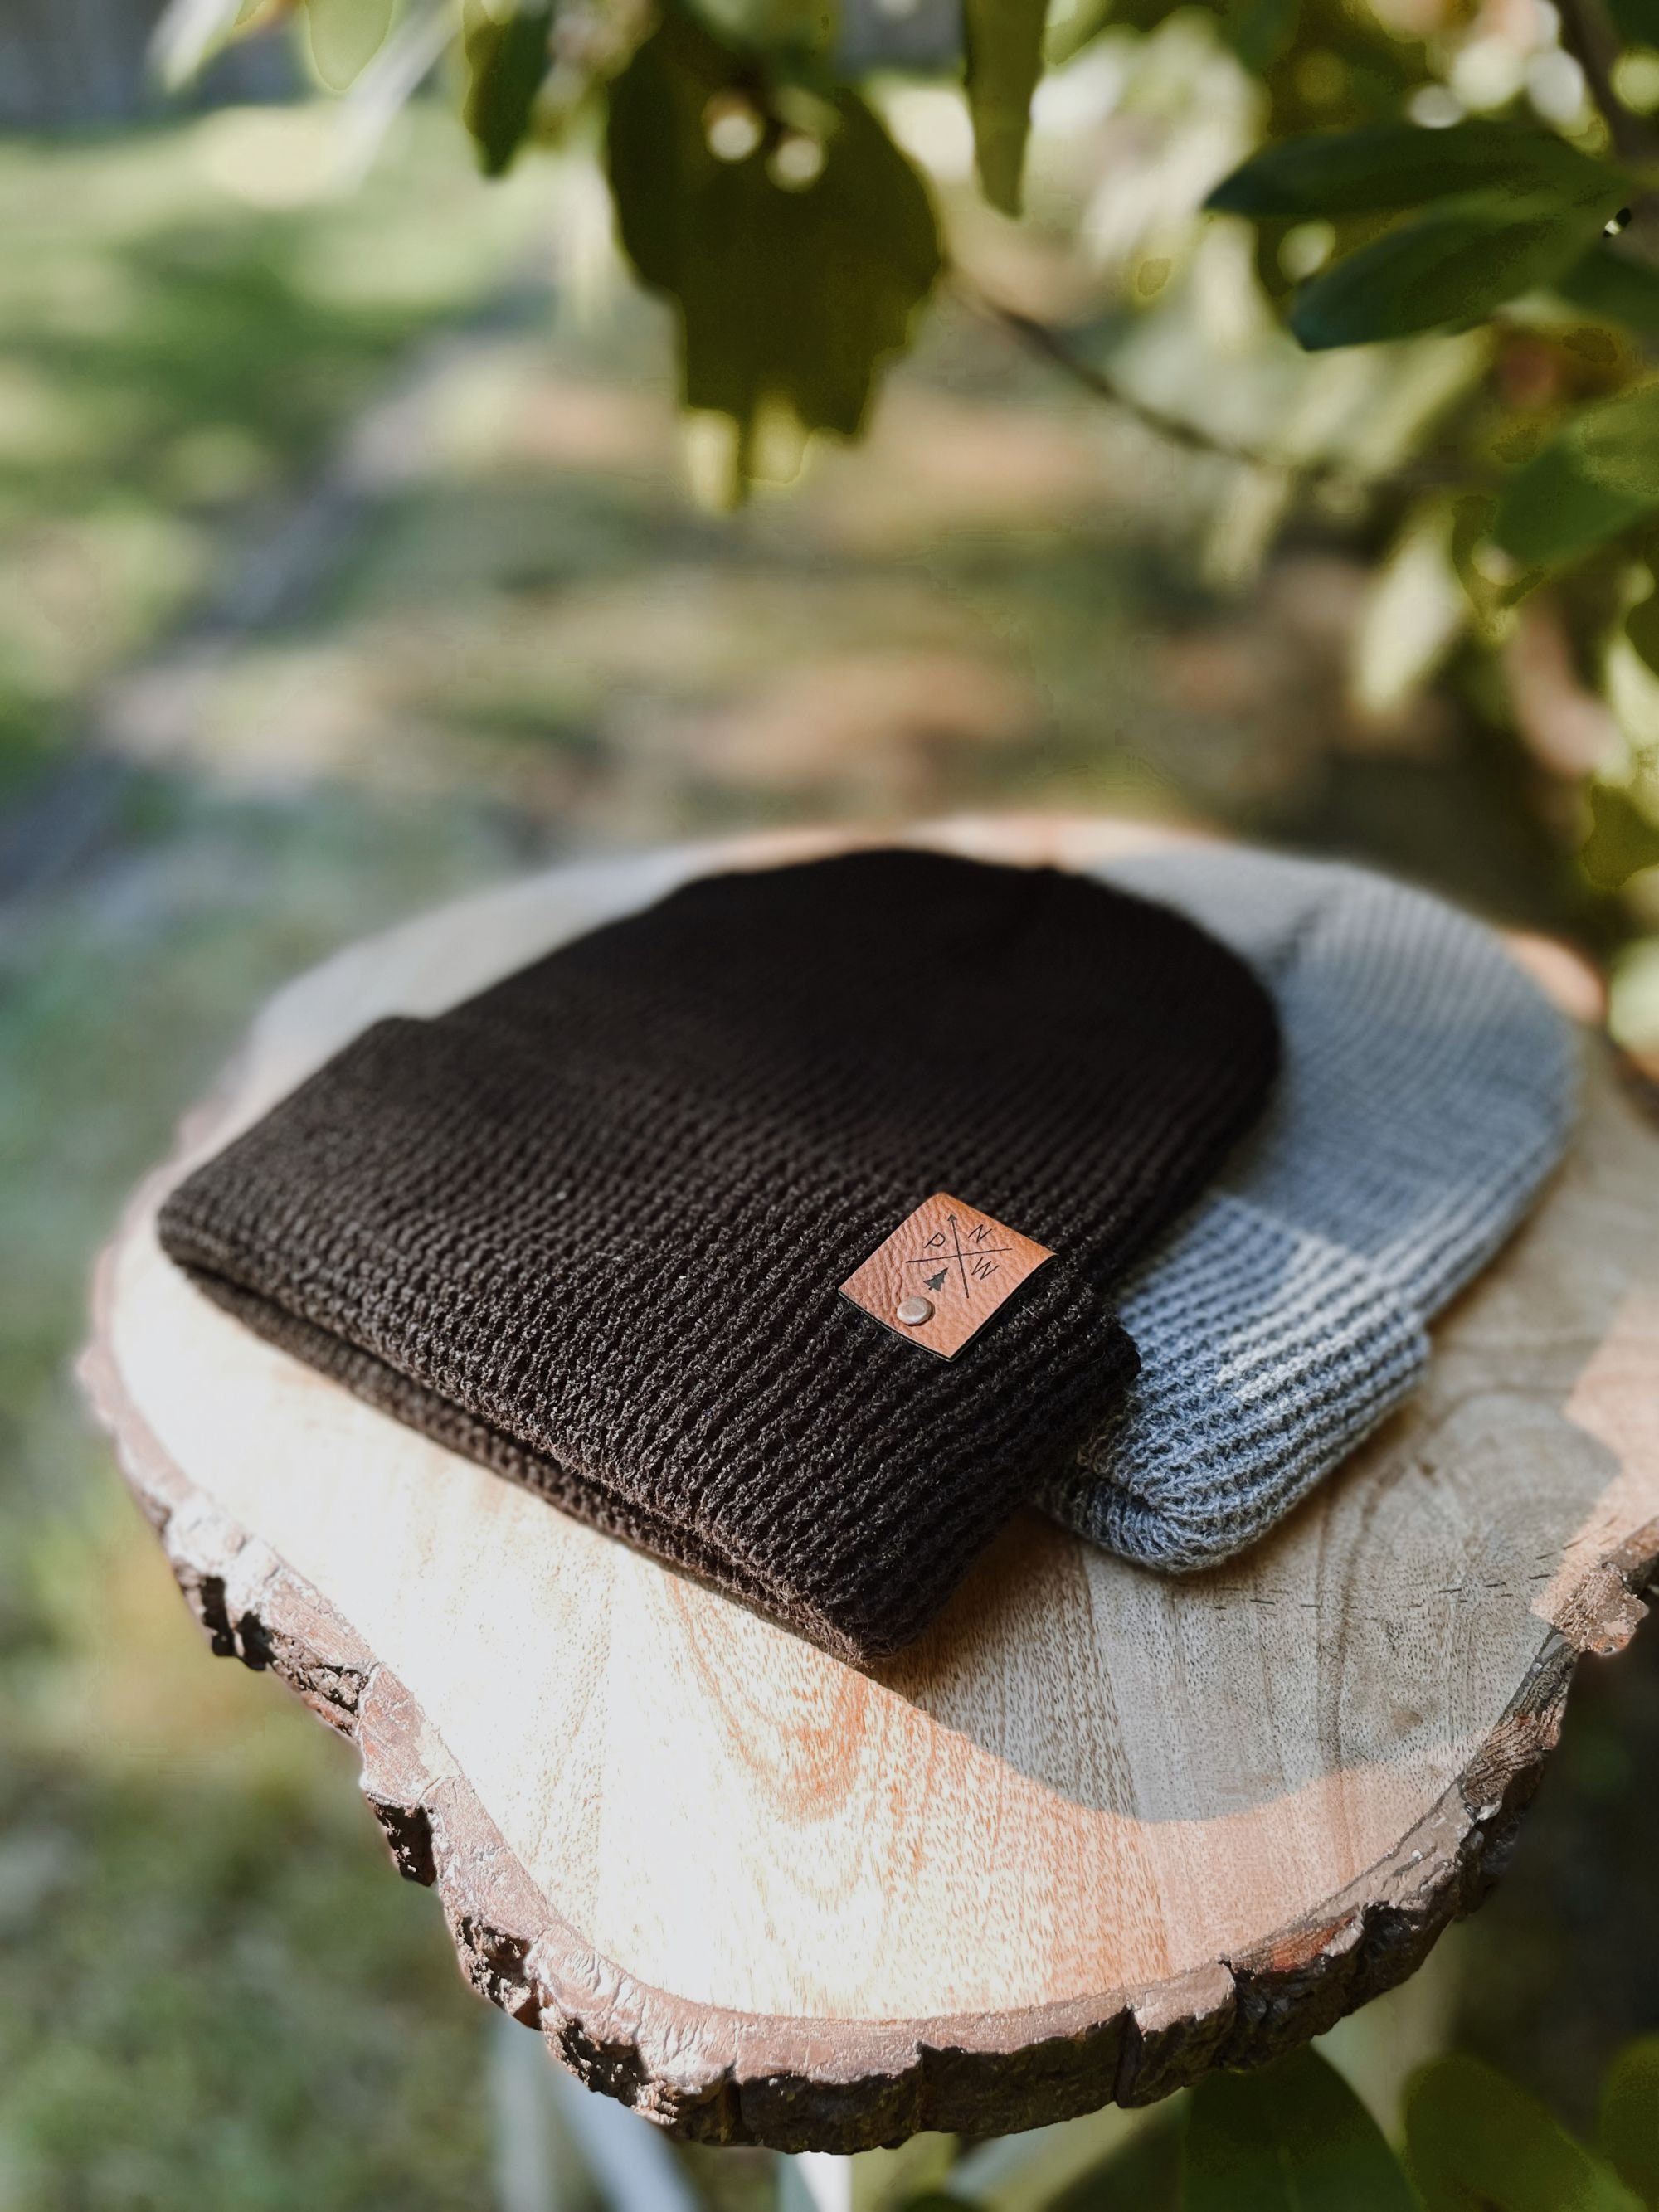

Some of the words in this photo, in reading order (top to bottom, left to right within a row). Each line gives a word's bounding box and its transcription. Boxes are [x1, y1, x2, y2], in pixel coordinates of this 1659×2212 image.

[923, 1232, 946, 1248] P
[967, 1223, 993, 1243] N
[971, 1257, 1000, 1280] W
